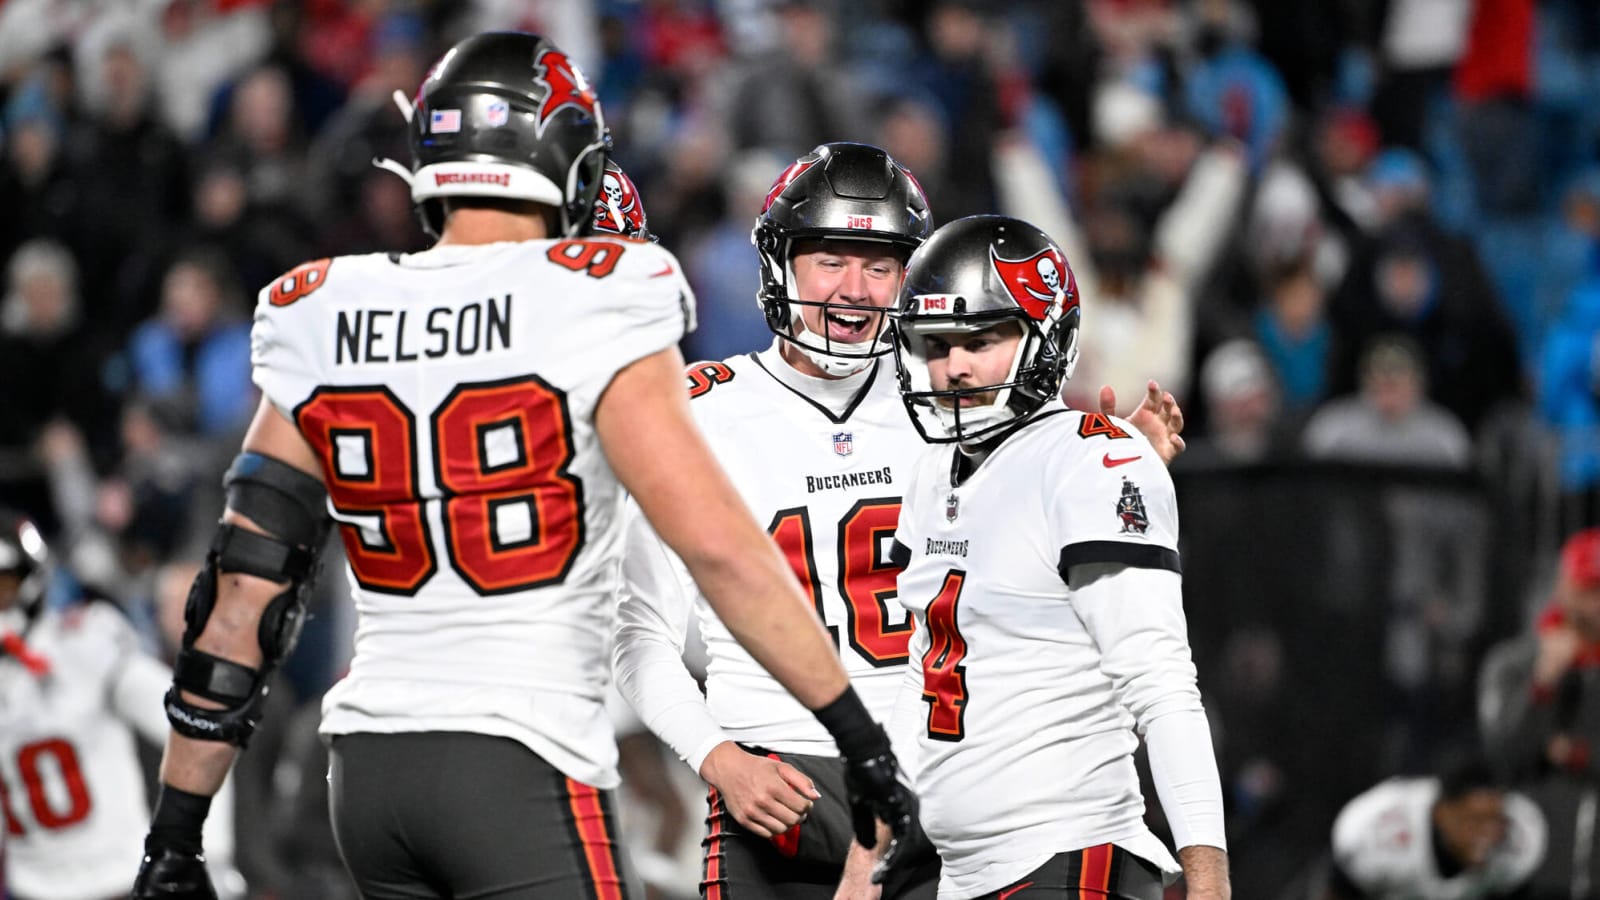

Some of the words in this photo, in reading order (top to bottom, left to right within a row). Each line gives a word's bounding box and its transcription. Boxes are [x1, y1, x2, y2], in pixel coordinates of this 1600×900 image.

[336, 294, 513, 365] NELSON
[1077, 412, 1134, 440] 4
[835, 442, 853, 454] NFL
[292, 373, 586, 597] 98
[806, 466, 893, 494] BUCCANEERS
[925, 537, 969, 558] BUCCANEERS
[921, 568, 970, 742] 4
